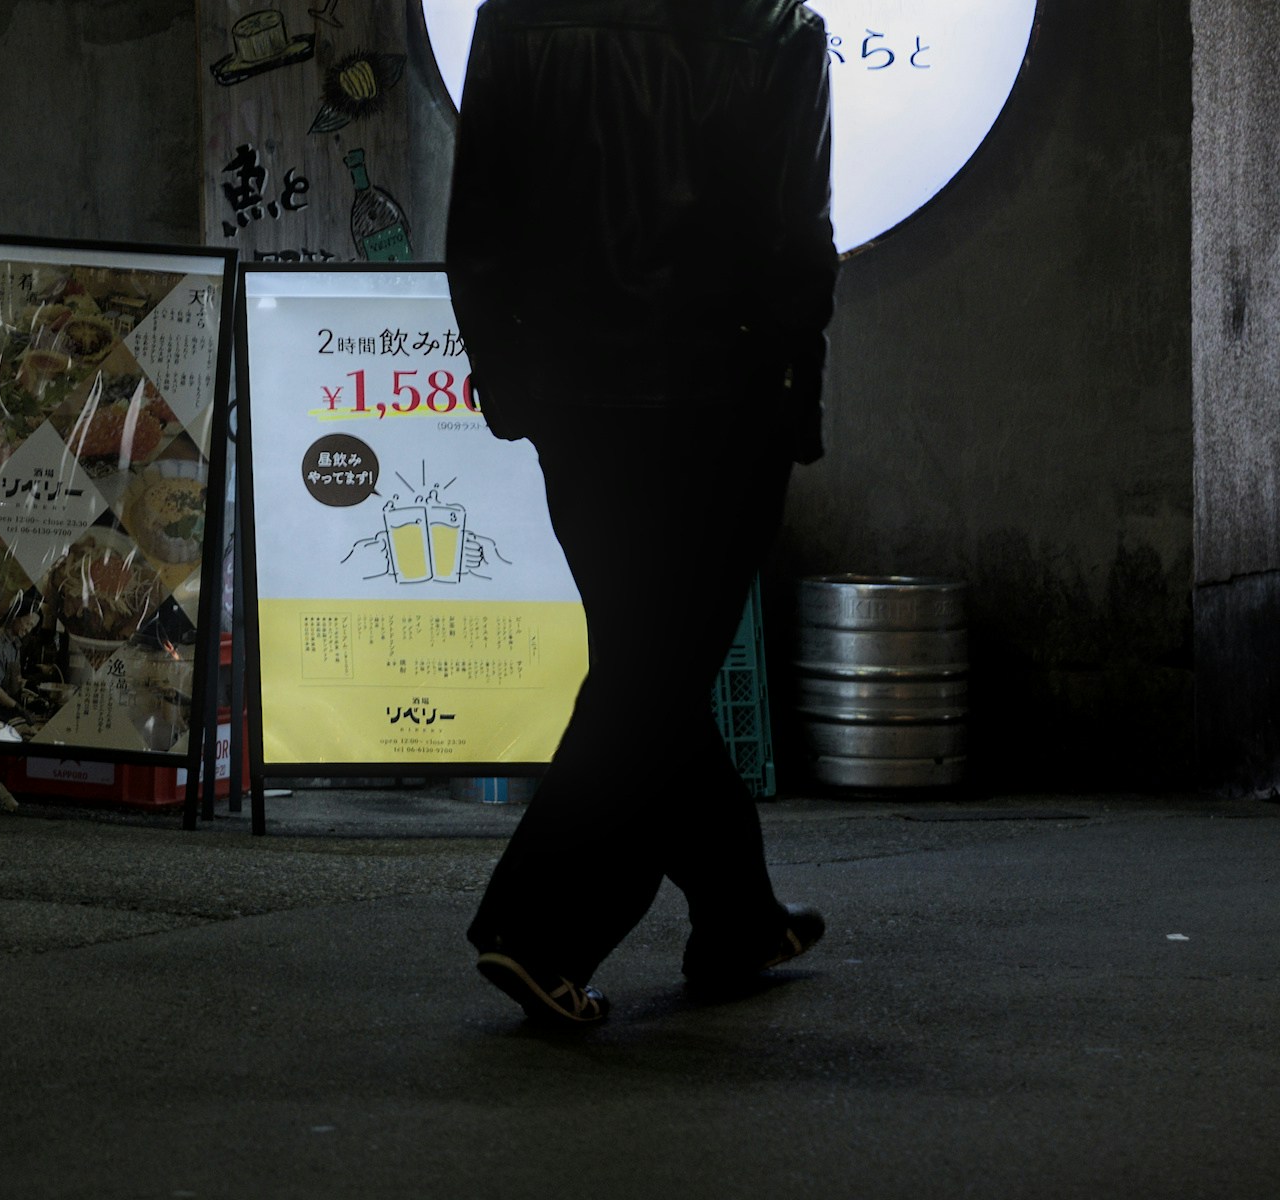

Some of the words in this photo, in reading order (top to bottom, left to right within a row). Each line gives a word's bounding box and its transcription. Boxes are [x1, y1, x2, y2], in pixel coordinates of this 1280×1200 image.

[318, 452, 361, 468] 昼飲み
[386, 706, 456, 725] リベリー
[53, 768, 88, 780] SAPPORO
